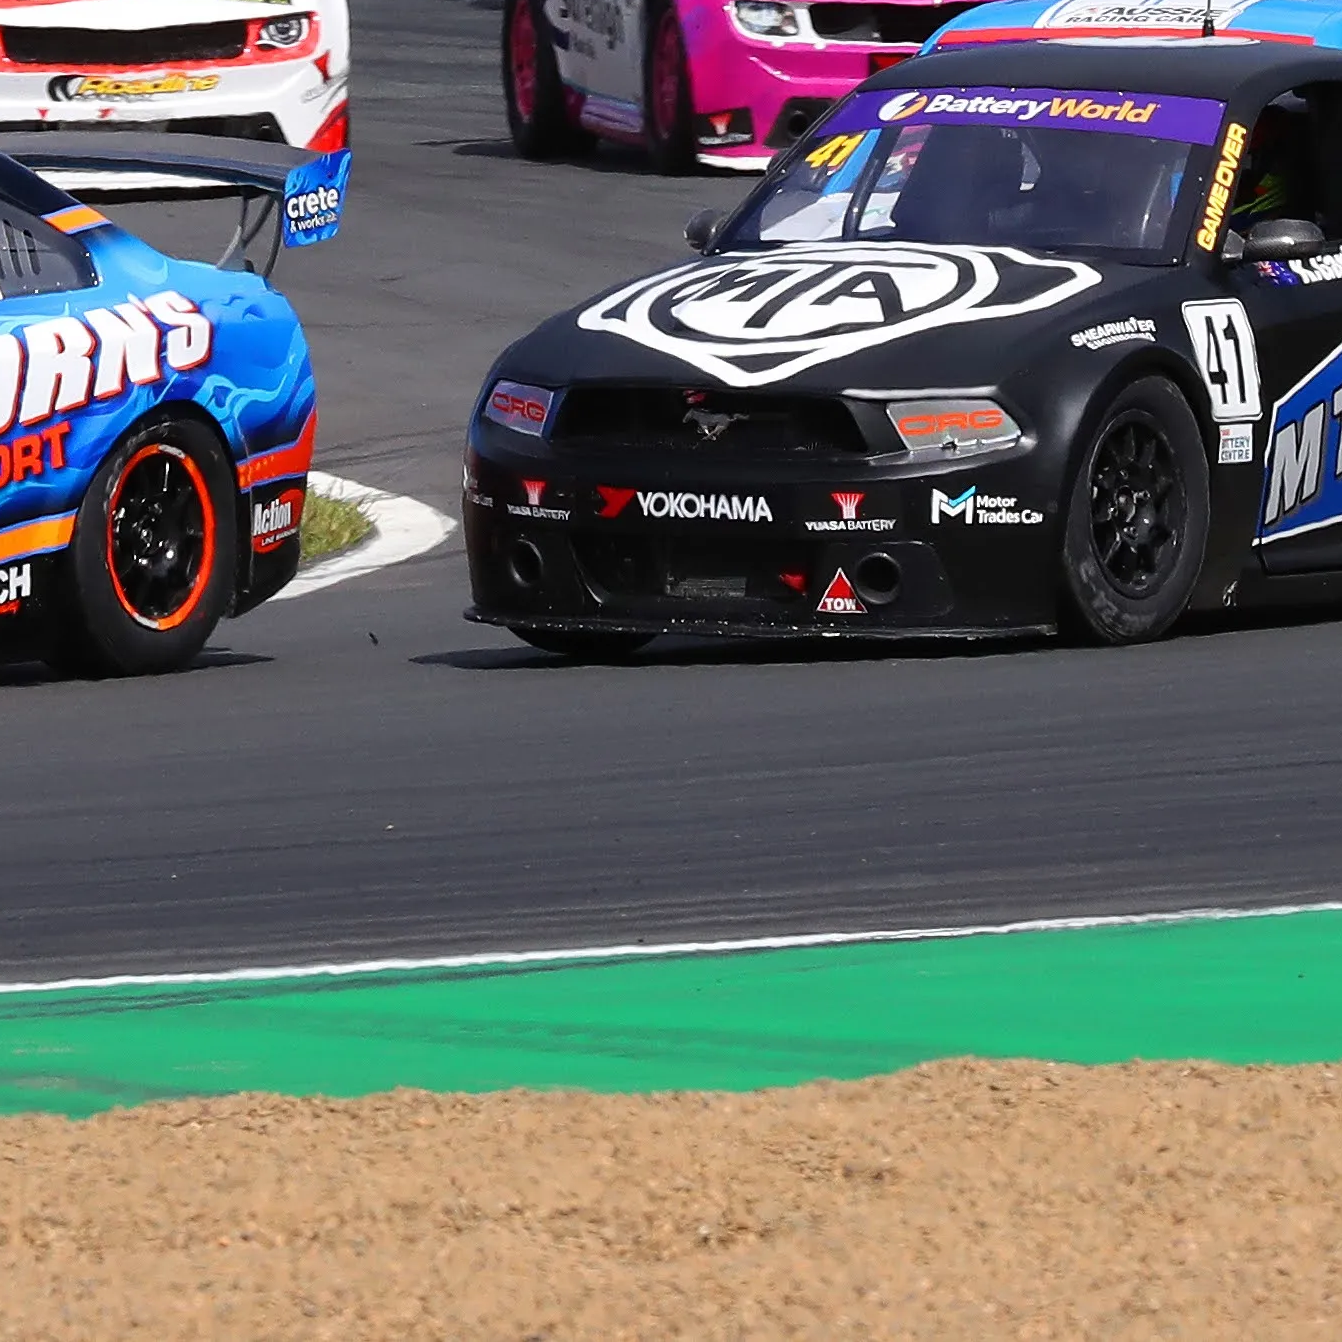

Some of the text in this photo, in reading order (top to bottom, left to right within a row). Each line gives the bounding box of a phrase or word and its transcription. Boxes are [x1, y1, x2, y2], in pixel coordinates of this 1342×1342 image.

[1064, 15, 1149, 24] RACING
[1100, 7, 1232, 18] AUSSIE
[78, 71, 220, 95] Roadline
[926, 94, 1156, 123] BatteryWorld
[805, 133, 866, 169] 41
[287, 186, 339, 219] crete
[1070, 316, 1157, 347] SHEARWATER
[1204, 314, 1248, 405] 41
[636, 491, 774, 522] YOKOHAMA
[976, 494, 1017, 508] Motor
[253, 498, 291, 537] Action
[976, 509, 1020, 525] Trades
[824, 597, 858, 611] TOW
